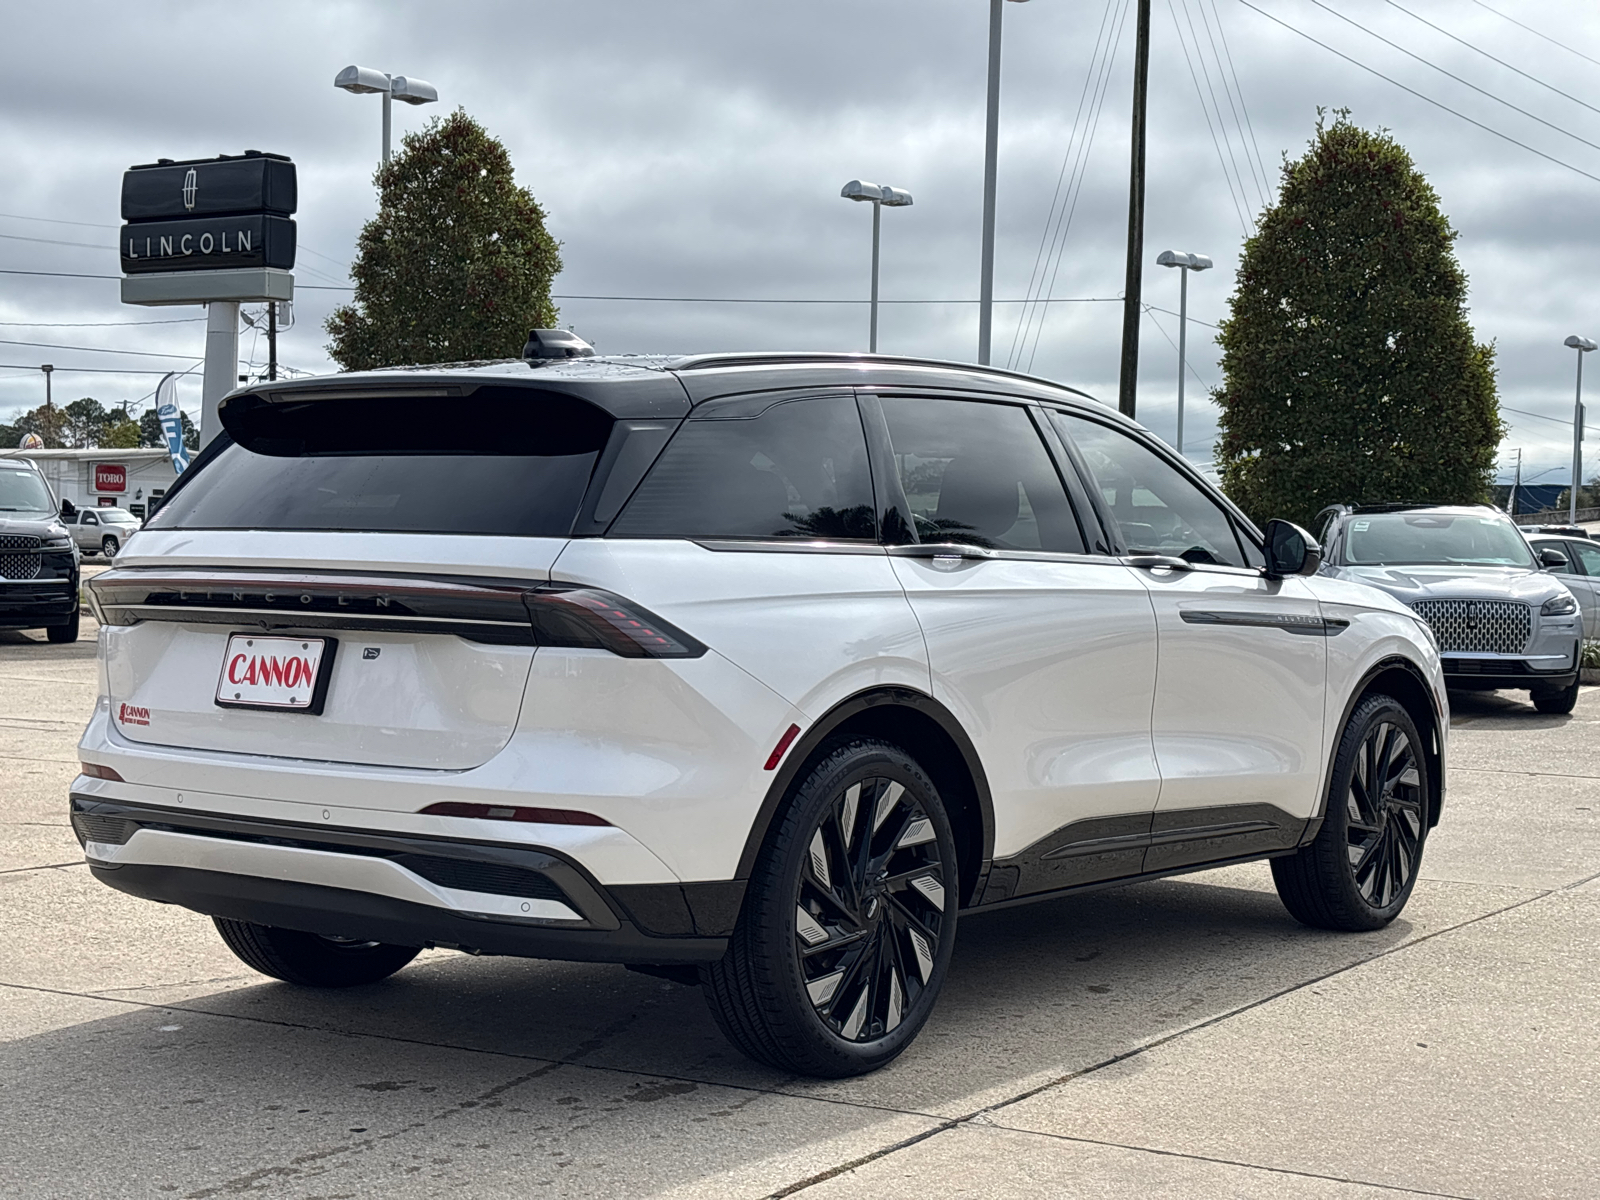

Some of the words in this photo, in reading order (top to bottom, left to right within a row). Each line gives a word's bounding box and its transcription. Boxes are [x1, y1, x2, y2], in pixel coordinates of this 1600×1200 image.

[129, 230, 251, 258] LINCOLN
[97, 473, 124, 484] TORO
[180, 589, 390, 607] LINCOLN
[228, 653, 317, 689] CANNON
[125, 705, 151, 720] CANNON
